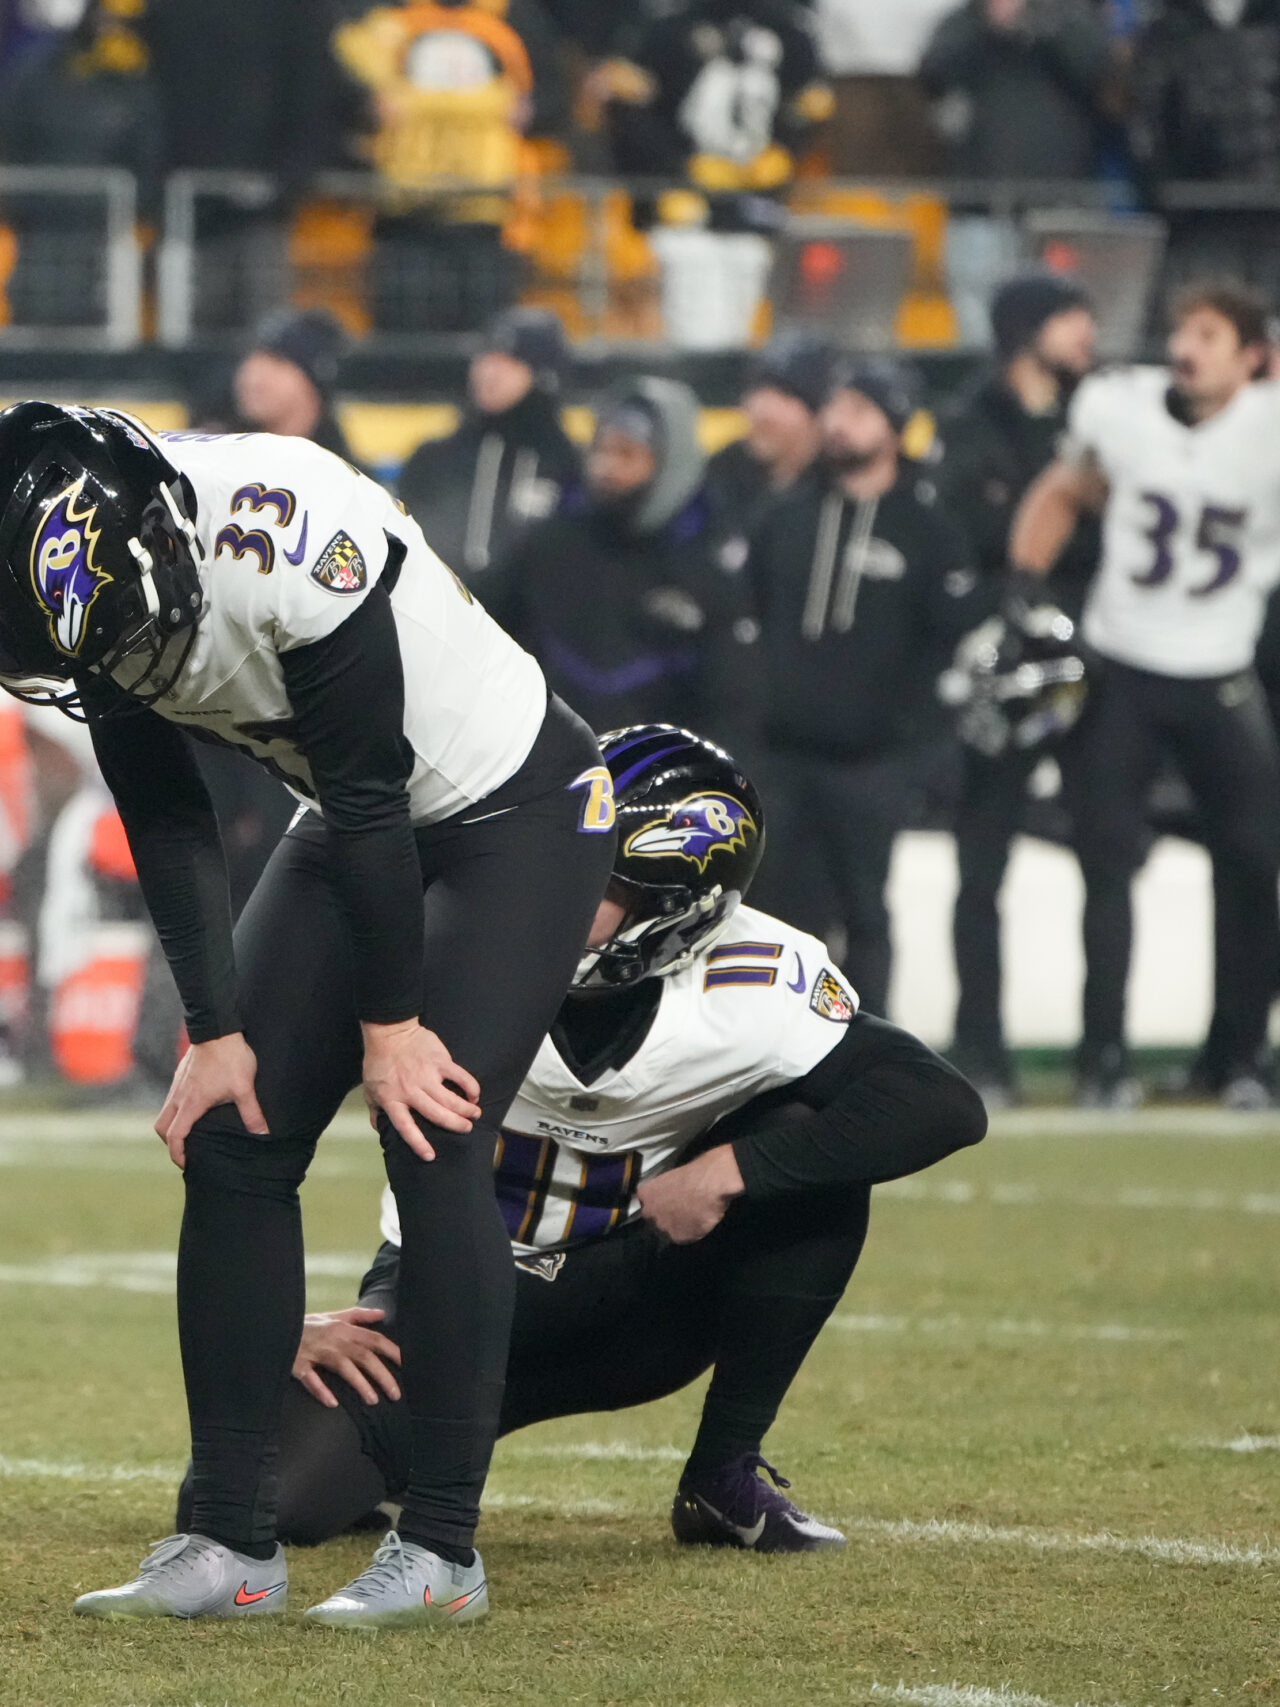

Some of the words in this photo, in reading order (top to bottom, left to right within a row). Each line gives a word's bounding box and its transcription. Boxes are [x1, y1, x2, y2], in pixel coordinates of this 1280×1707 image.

[214, 482, 297, 576] 33
[1130, 488, 1248, 599] 35
[695, 941, 785, 994] 11
[536, 1120, 609, 1146] RAVENS
